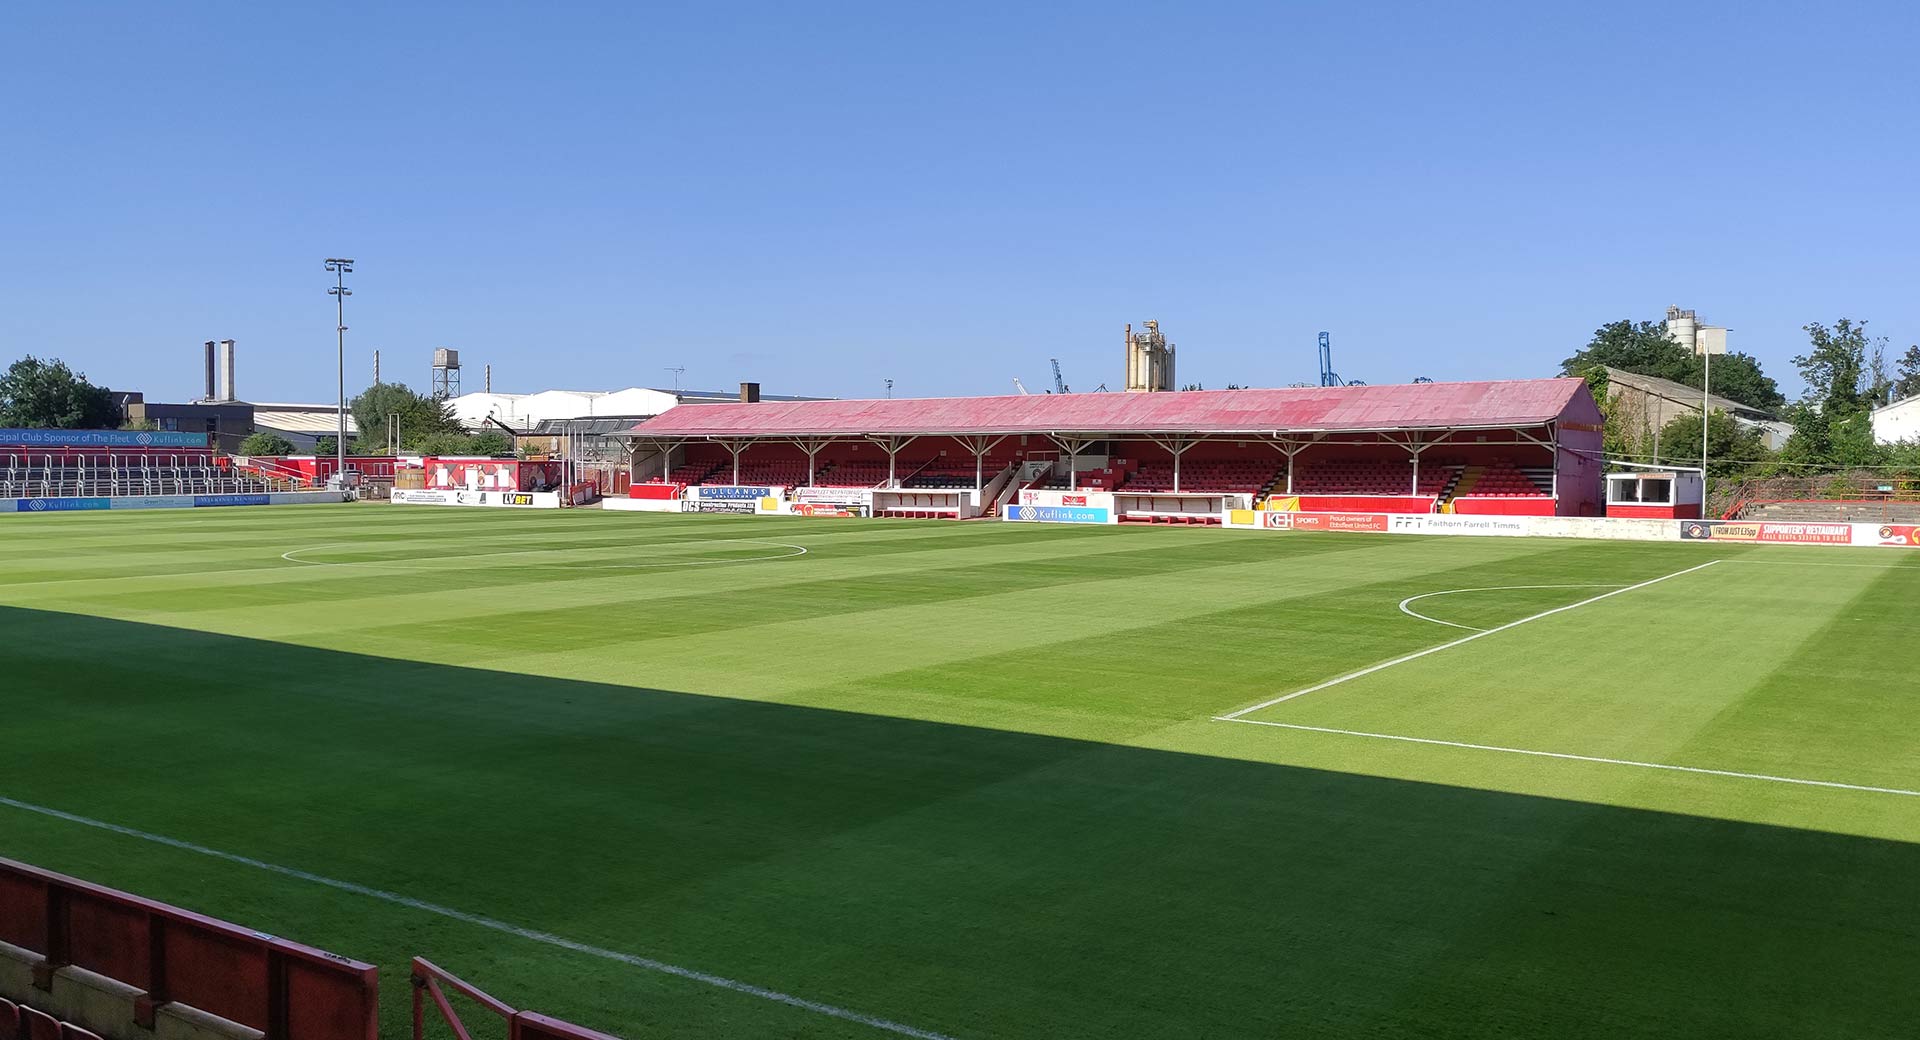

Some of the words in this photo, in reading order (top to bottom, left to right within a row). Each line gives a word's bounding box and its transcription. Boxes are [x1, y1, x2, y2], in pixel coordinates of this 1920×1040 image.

[0, 432, 19, 442] cipal
[22, 432, 42, 442] Club
[44, 433, 79, 443] Sponsor
[92, 434, 108, 442] The
[110, 434, 129, 443] Fleet
[154, 436, 202, 444] Kuflink.com
[1040, 510, 1094, 520] Kuflink.com
[1266, 513, 1294, 527] KEH
[1716, 526, 1728, 534] FROM
[1729, 527, 1740, 535] JUST
[1806, 525, 1848, 535] RESTAURANT
